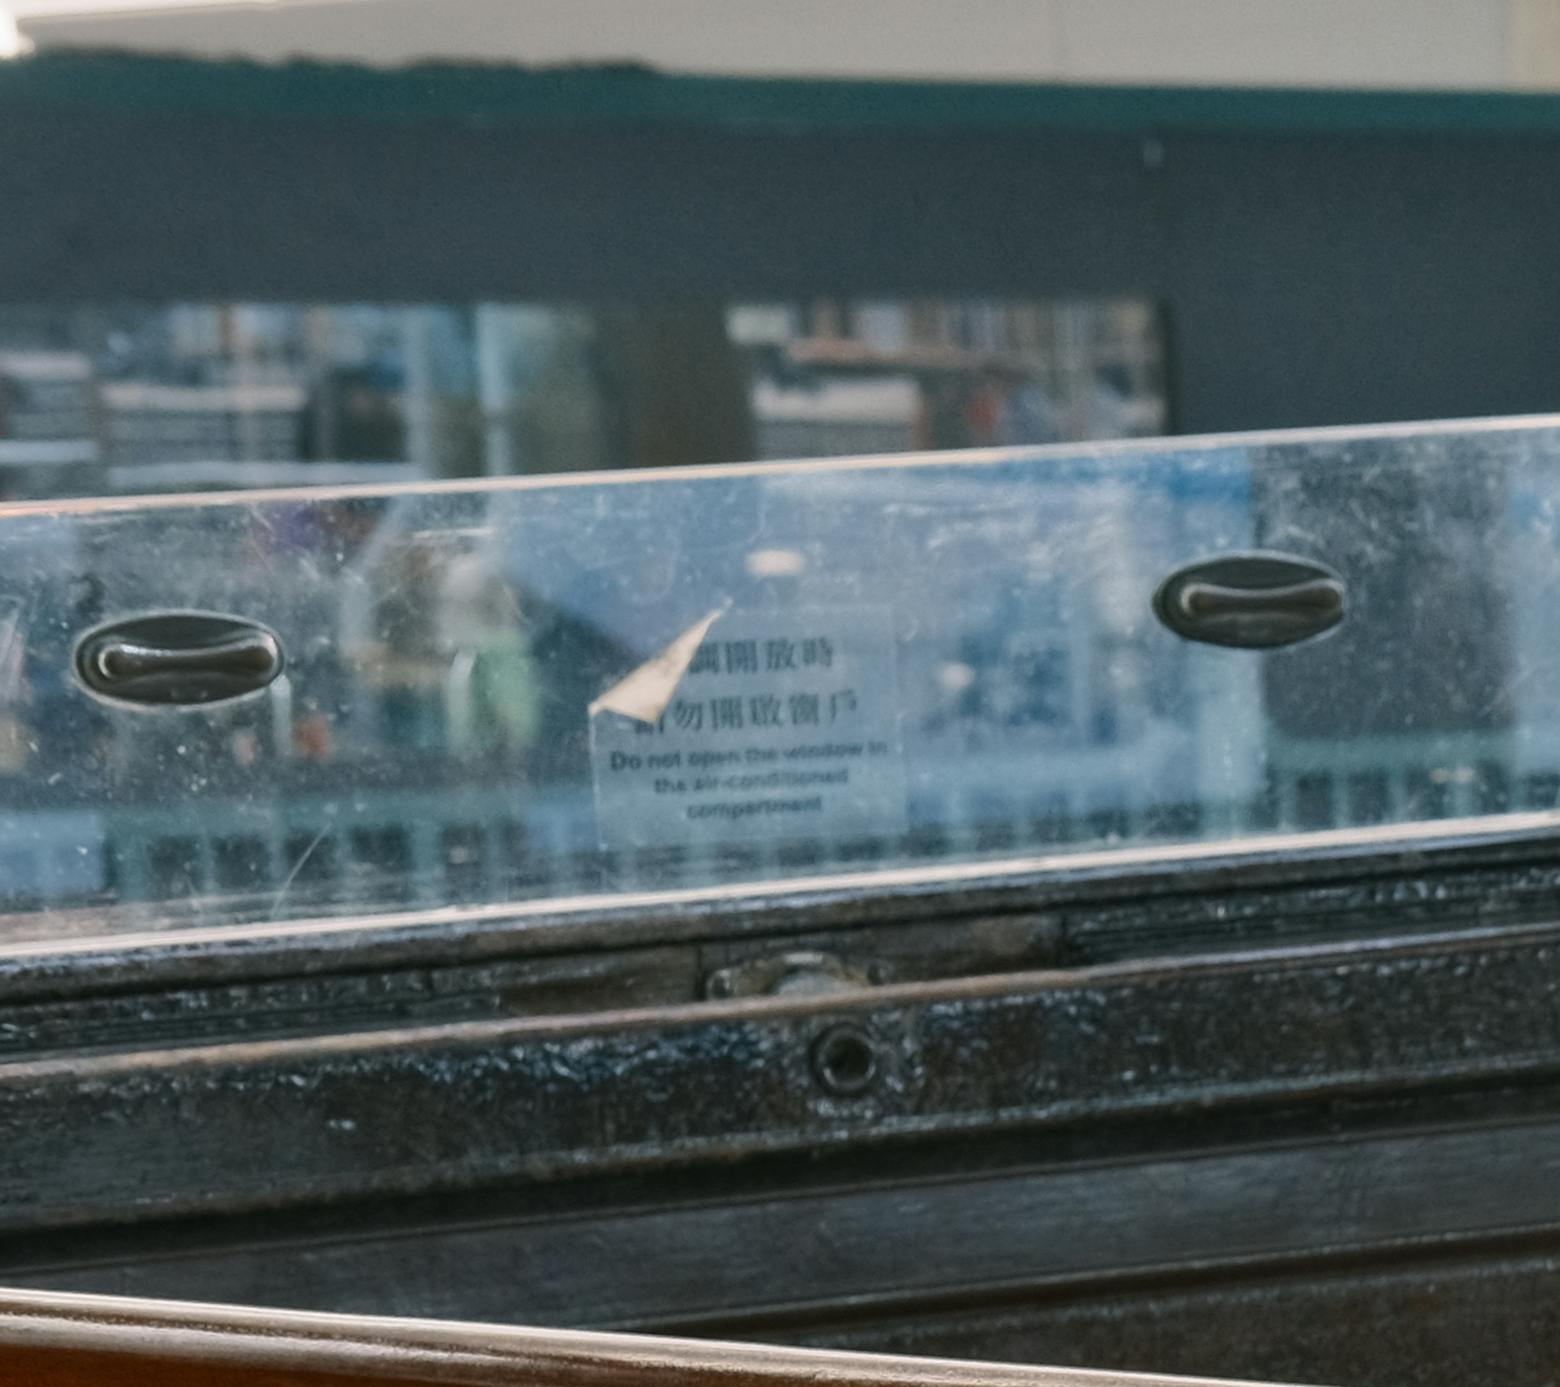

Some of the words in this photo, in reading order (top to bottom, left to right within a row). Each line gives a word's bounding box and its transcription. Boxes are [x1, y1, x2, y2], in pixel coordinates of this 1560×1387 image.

[610, 750, 642, 772] Do
[647, 749, 682, 769] not
[688, 748, 741, 769] open
[745, 746, 778, 763] the
[783, 742, 863, 762] window
[653, 778, 687, 794] the
[686, 796, 822, 819] compartment
